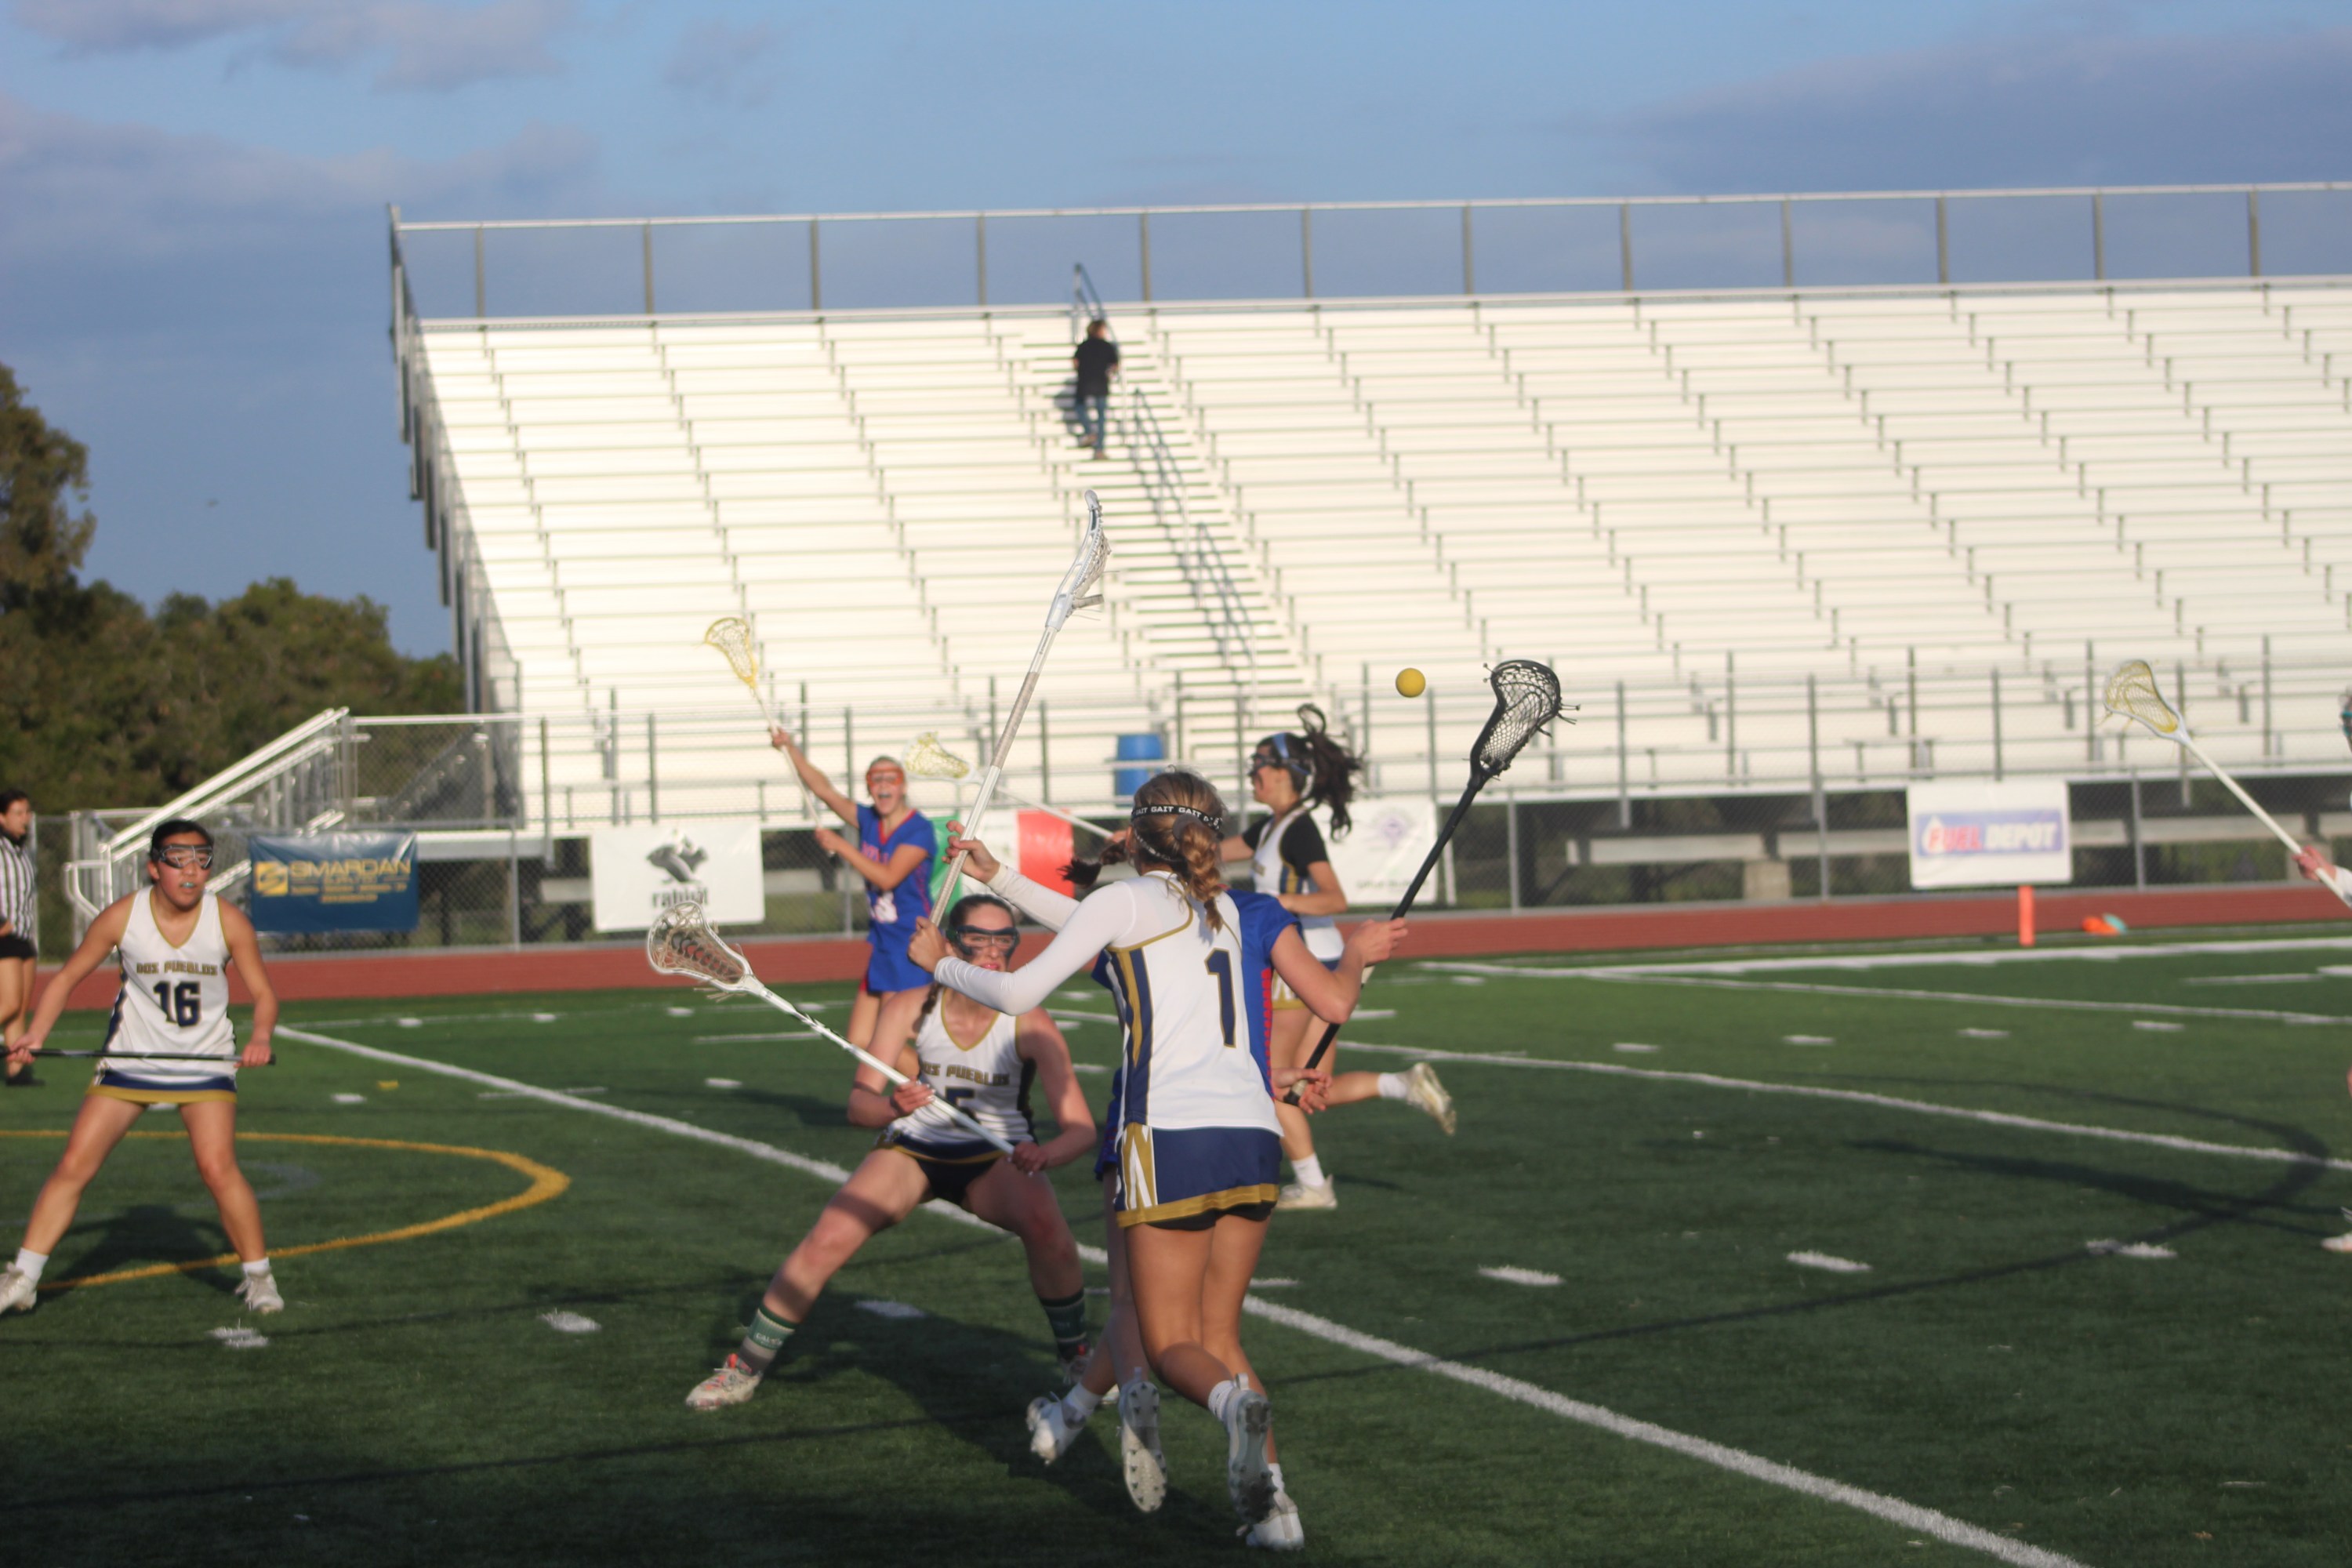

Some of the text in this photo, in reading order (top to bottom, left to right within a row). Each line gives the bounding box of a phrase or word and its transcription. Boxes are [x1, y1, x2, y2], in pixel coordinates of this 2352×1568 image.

[1178, 807, 1202, 818] GAIT
[1928, 821, 2057, 854] FUEL DEPOT
[290, 858, 412, 879] SMARDAN
[136, 960, 219, 977] DOS PUEBLOS
[153, 980, 202, 1028] 16
[1204, 946, 1236, 1048] 1
[946, 1064, 1011, 1087] PUEBLOS
